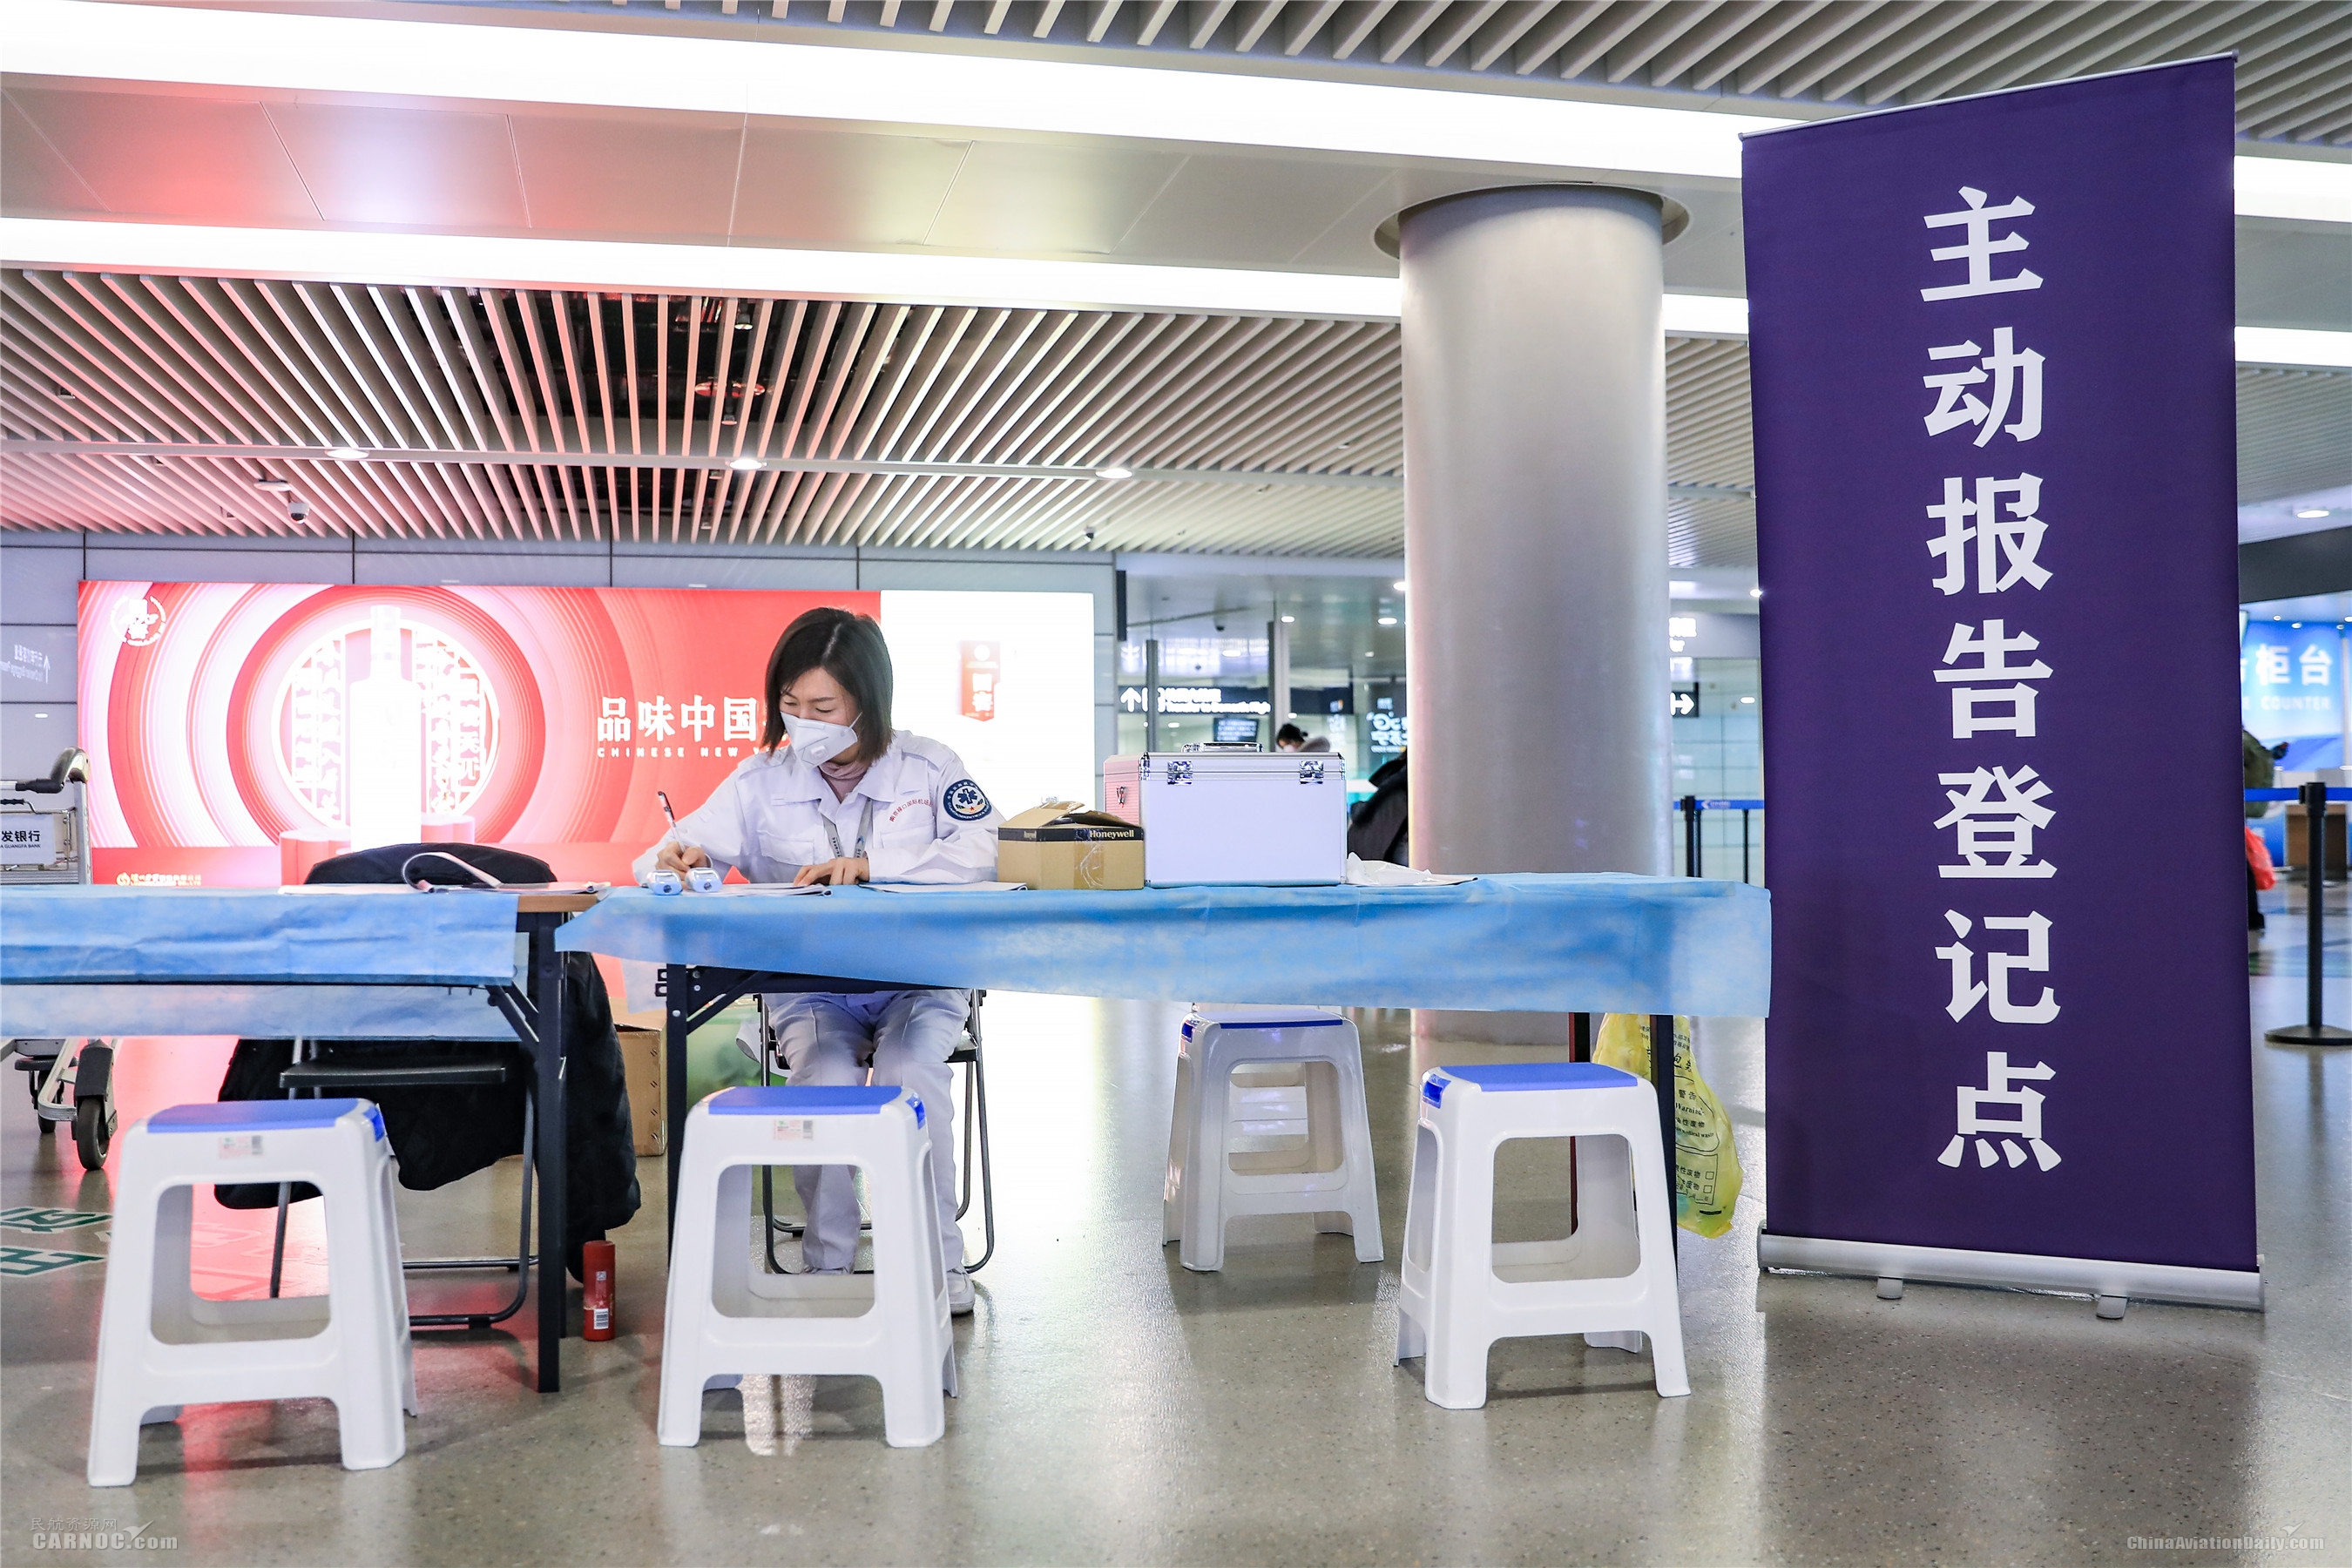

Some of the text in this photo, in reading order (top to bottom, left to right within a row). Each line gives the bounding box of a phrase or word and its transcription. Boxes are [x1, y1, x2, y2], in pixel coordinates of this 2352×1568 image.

[1922, 185, 2063, 1173] 主动报告登记点
[597, 694, 768, 742] 品味中国
[597, 747, 739, 758] CHINESE NEW
[1090, 829, 1134, 840] Honeywell
[1678, 1089, 1697, 1100] 警告
